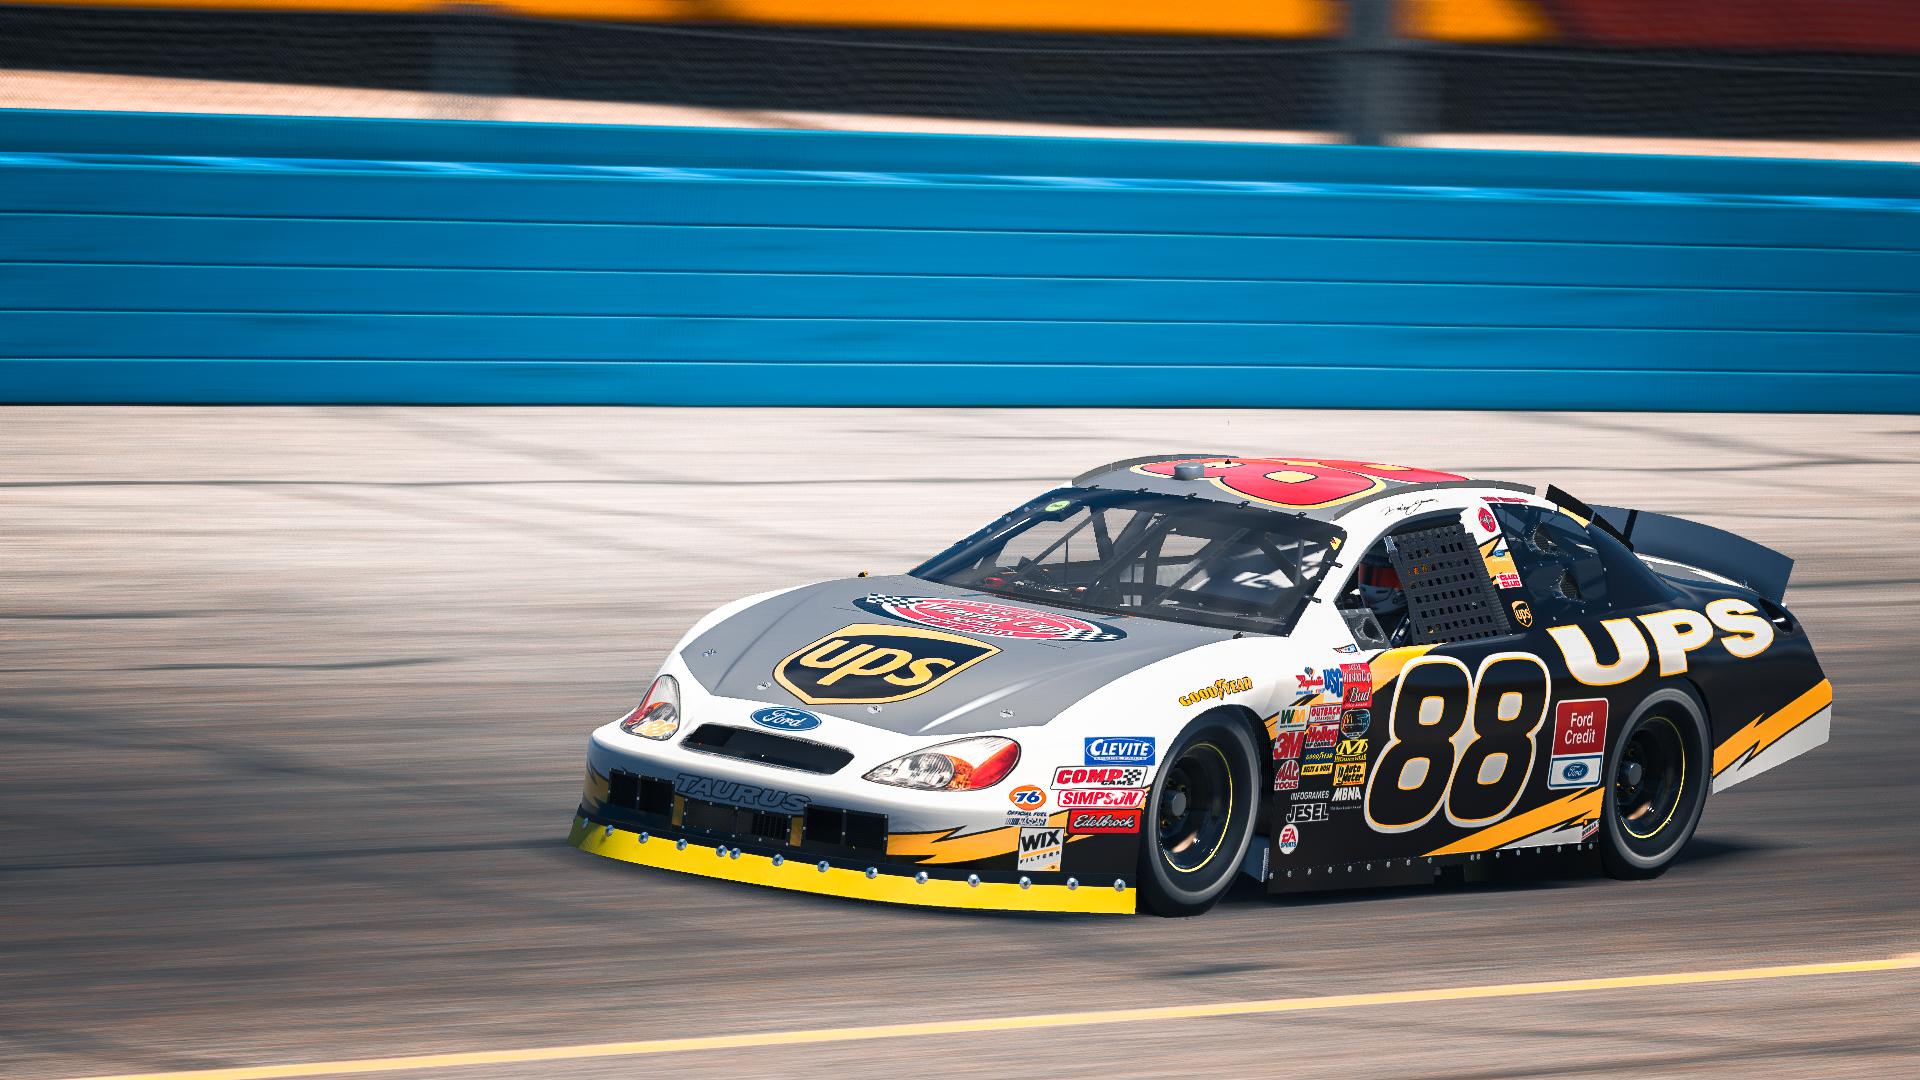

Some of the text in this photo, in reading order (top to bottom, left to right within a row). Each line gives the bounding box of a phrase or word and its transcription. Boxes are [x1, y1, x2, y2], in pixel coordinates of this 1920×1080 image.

[1546, 599, 1774, 686] UPS
[799, 640, 956, 687] ups
[1178, 676, 1253, 707] GOODYEAR
[762, 708, 805, 727] Ford
[1311, 707, 1341, 717] OUTBACK
[1570, 711, 1594, 726] Ford
[1273, 732, 1304, 758] 3M
[1365, 654, 1551, 833] 88
[1564, 729, 1596, 745] Credit
[1090, 738, 1150, 756] CLEVITE
[1057, 769, 1123, 784] COMP
[674, 772, 812, 812] TAURUS
[1015, 791, 1041, 803] 76
[1062, 792, 1136, 805] SIMPSON
[1290, 790, 1330, 801] INFOGRAMES
[1332, 787, 1362, 801] MBNA
[1073, 815, 1135, 828] Edelbrock
[1286, 803, 1329, 824] JESEL
[1021, 830, 1060, 852] WIX
[1281, 828, 1296, 842] EA
[1020, 850, 1060, 864] FILTERS
